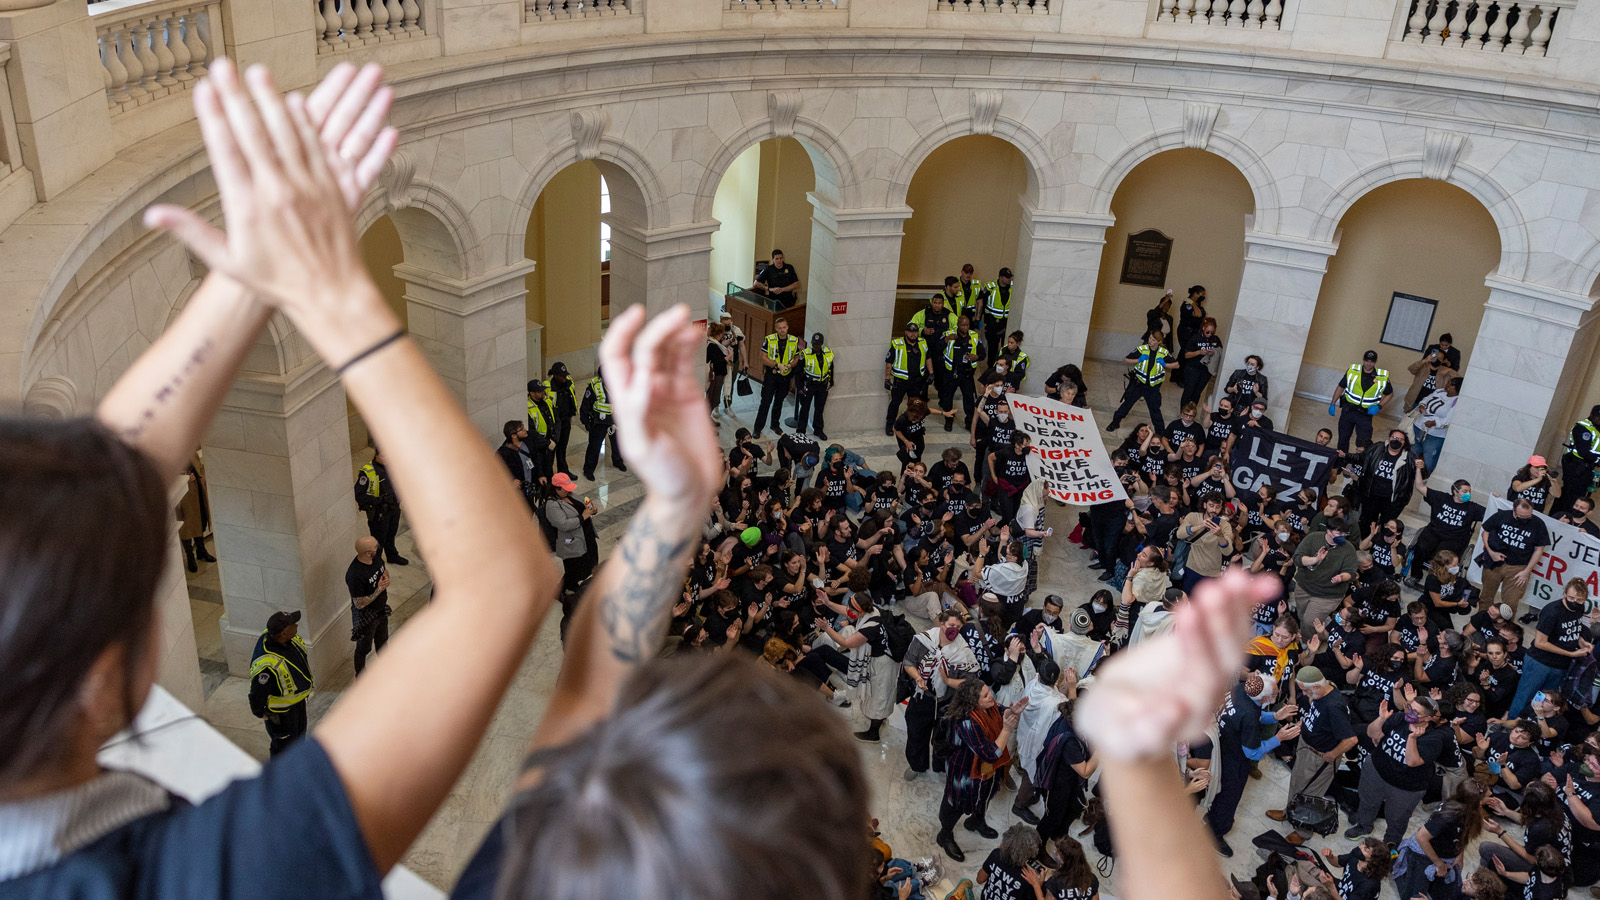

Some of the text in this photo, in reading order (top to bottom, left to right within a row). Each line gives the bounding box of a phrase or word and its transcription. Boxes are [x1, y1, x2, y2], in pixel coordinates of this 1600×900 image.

[832, 304, 847, 312] EXIT
[1426, 396, 1445, 414] 10
[1013, 400, 1084, 422] MOURN
[1033, 416, 1067, 430] THE
[996, 432, 1010, 440] OUR
[1038, 439, 1075, 448] AND
[1029, 446, 1092, 460] FIGHT
[1248, 436, 1330, 481] LET
[1040, 458, 1090, 472] LIKE
[1146, 456, 1158, 464] NOT
[1146, 462, 1162, 470] OUR
[1040, 466, 1100, 482] HELL
[1073, 479, 1112, 490] THE
[1522, 490, 1542, 498] OUR
[1442, 504, 1457, 514] NOT
[1436, 512, 1463, 526] NAME
[1443, 510, 1462, 521] OUR
[1501, 524, 1518, 533] NOT
[1502, 530, 1525, 542] OUR
[1373, 544, 1386, 554] NOT
[1552, 531, 1600, 567] Y JE
[1531, 552, 1598, 597] ER A
[1532, 580, 1553, 600] IS
[1252, 607, 1270, 617] OUR
[1562, 620, 1576, 629] NOT
[1402, 628, 1412, 636] OT
[1566, 626, 1582, 635] OUR
[1367, 670, 1386, 684] NOT
[1386, 738, 1406, 756] OUR
[1581, 790, 1592, 800] IN
[990, 863, 1021, 890] JEWS
[990, 872, 1014, 894] SAY
